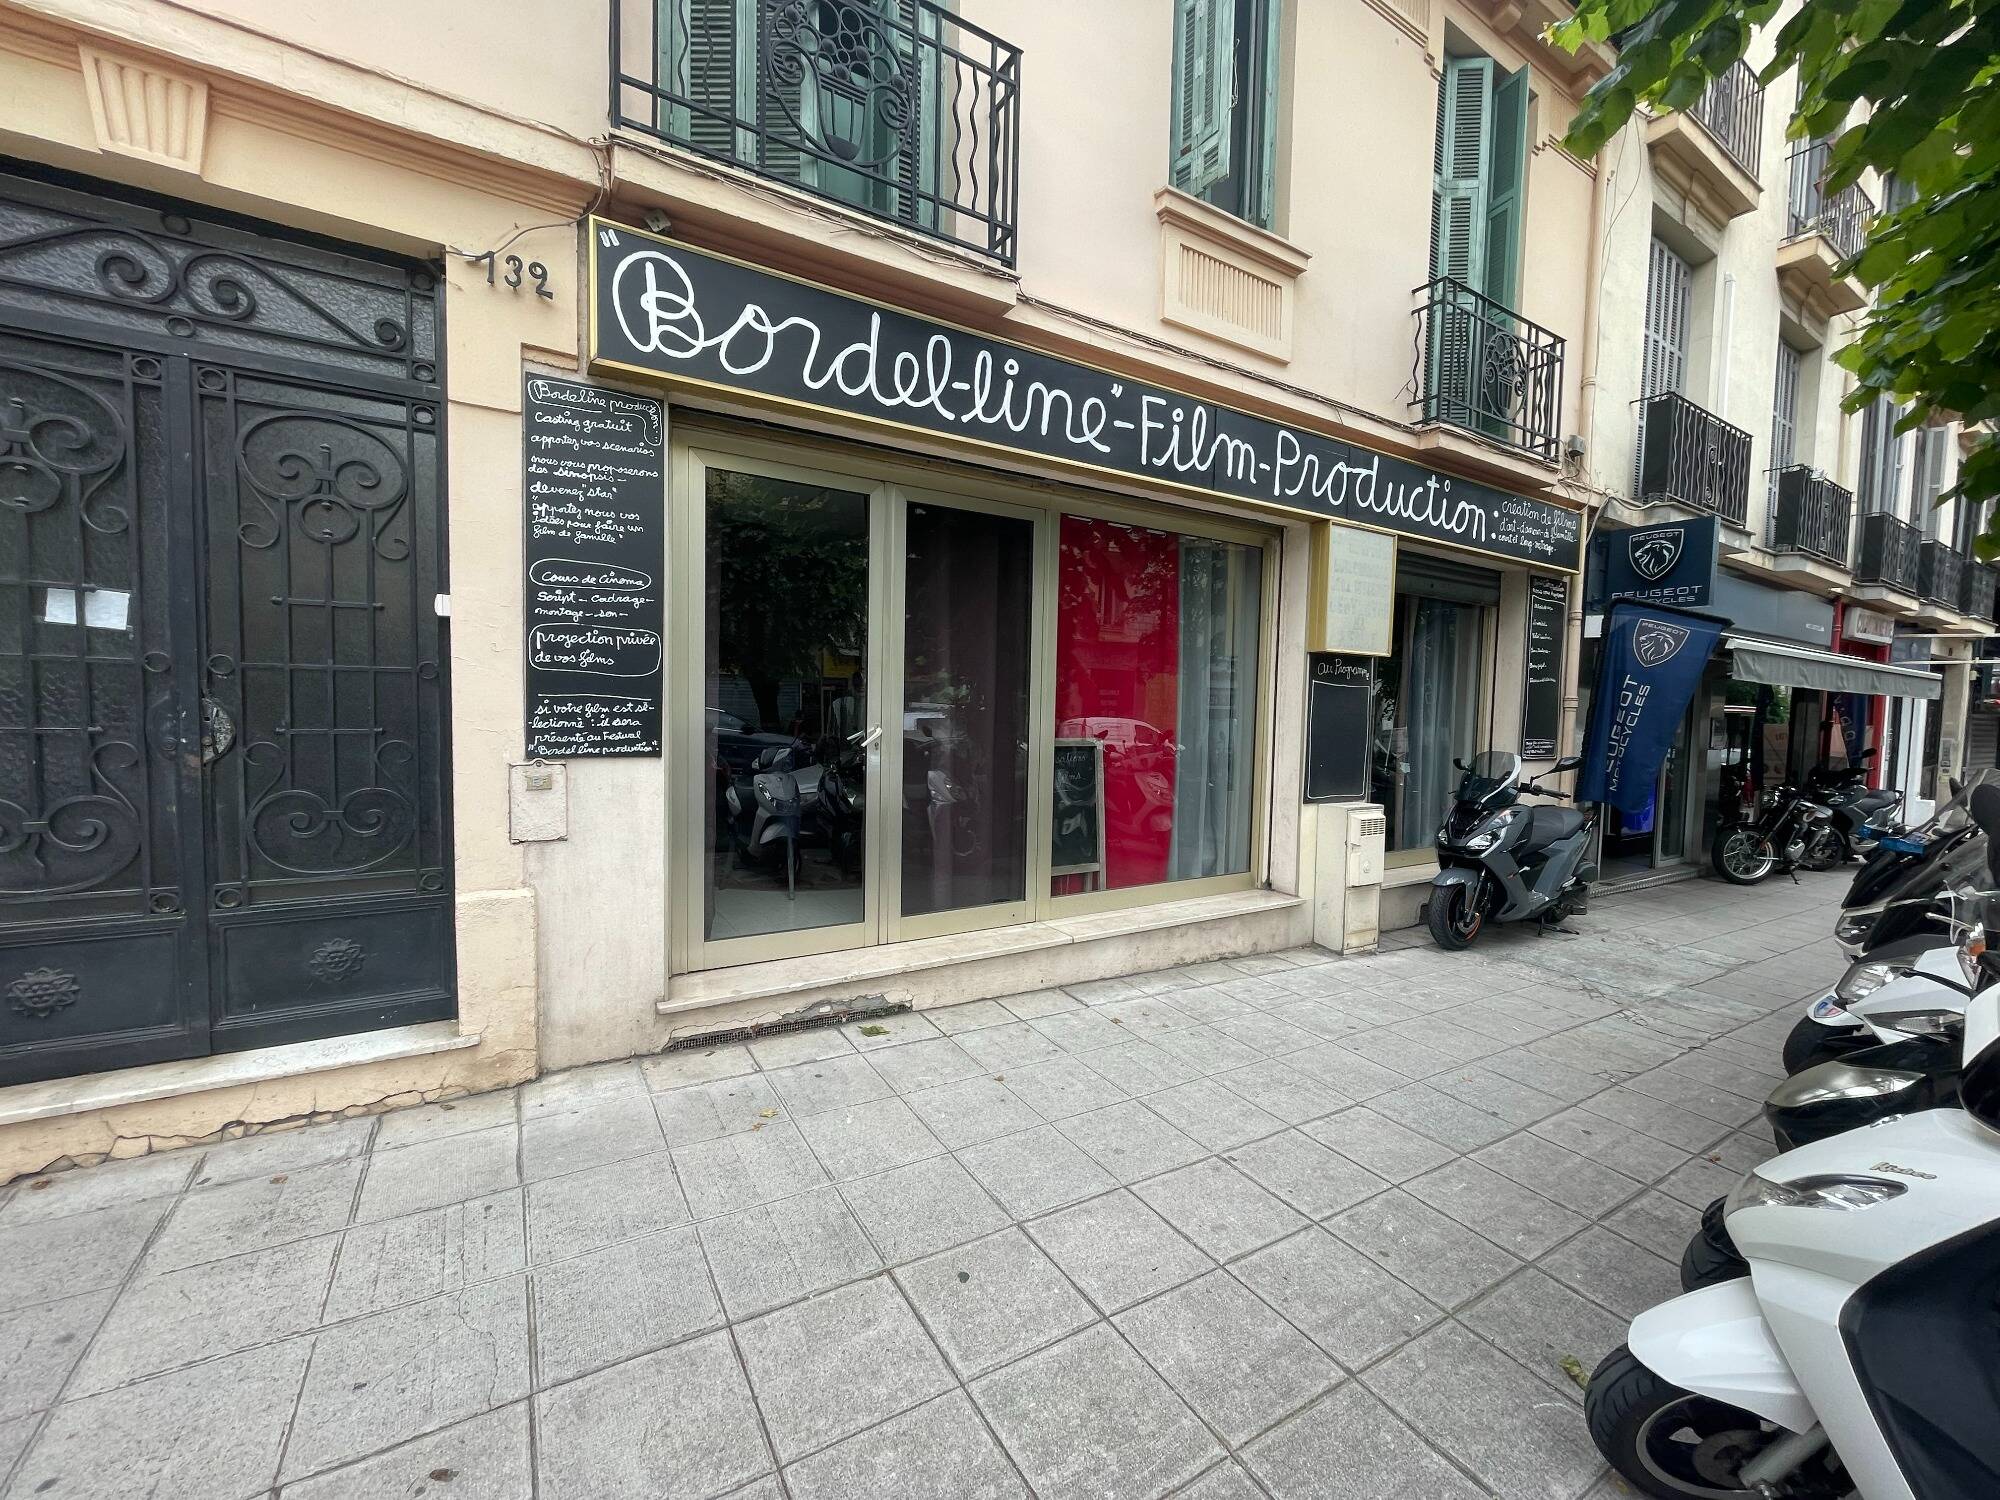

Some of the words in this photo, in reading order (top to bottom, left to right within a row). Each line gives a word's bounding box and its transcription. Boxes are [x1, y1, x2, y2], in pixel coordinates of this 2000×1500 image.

[474, 250, 554, 300] 132
[534, 411, 581, 432] Casting
[582, 419, 633, 433] gratuit
[530, 434, 580, 451] apportez
[580, 438, 601, 448] vos
[528, 464, 548, 474] des
[530, 455, 559, 466] nous
[560, 459, 586, 470] vous
[586, 463, 659, 478] proposerons
[529, 481, 585, 502] devenez
[584, 508, 616, 518] nous
[619, 512, 640, 520] vos
[1540, 506, 1551, 526] de
[532, 524, 556, 538] film
[566, 520, 592, 528] pour
[594, 520, 625, 534] faire
[627, 525, 645, 533] un
[1632, 531, 1680, 541] PEUGEOT
[541, 571, 580, 582] Cours
[581, 574, 597, 584] de
[536, 589, 577, 604] Script
[1641, 622, 1685, 636] PEUGEOT
[535, 629, 614, 650] projection
[615, 632, 657, 650] privée
[534, 651, 552, 662] de
[553, 654, 576, 663] vos
[578, 648, 615, 668] films
[534, 699, 552, 714] si
[553, 702, 583, 713] votre
[584, 702, 611, 718] film
[612, 702, 634, 713] est
[611, 718, 643, 727] sera
[602, 731, 642, 741] Festival
[576, 742, 601, 754] line
